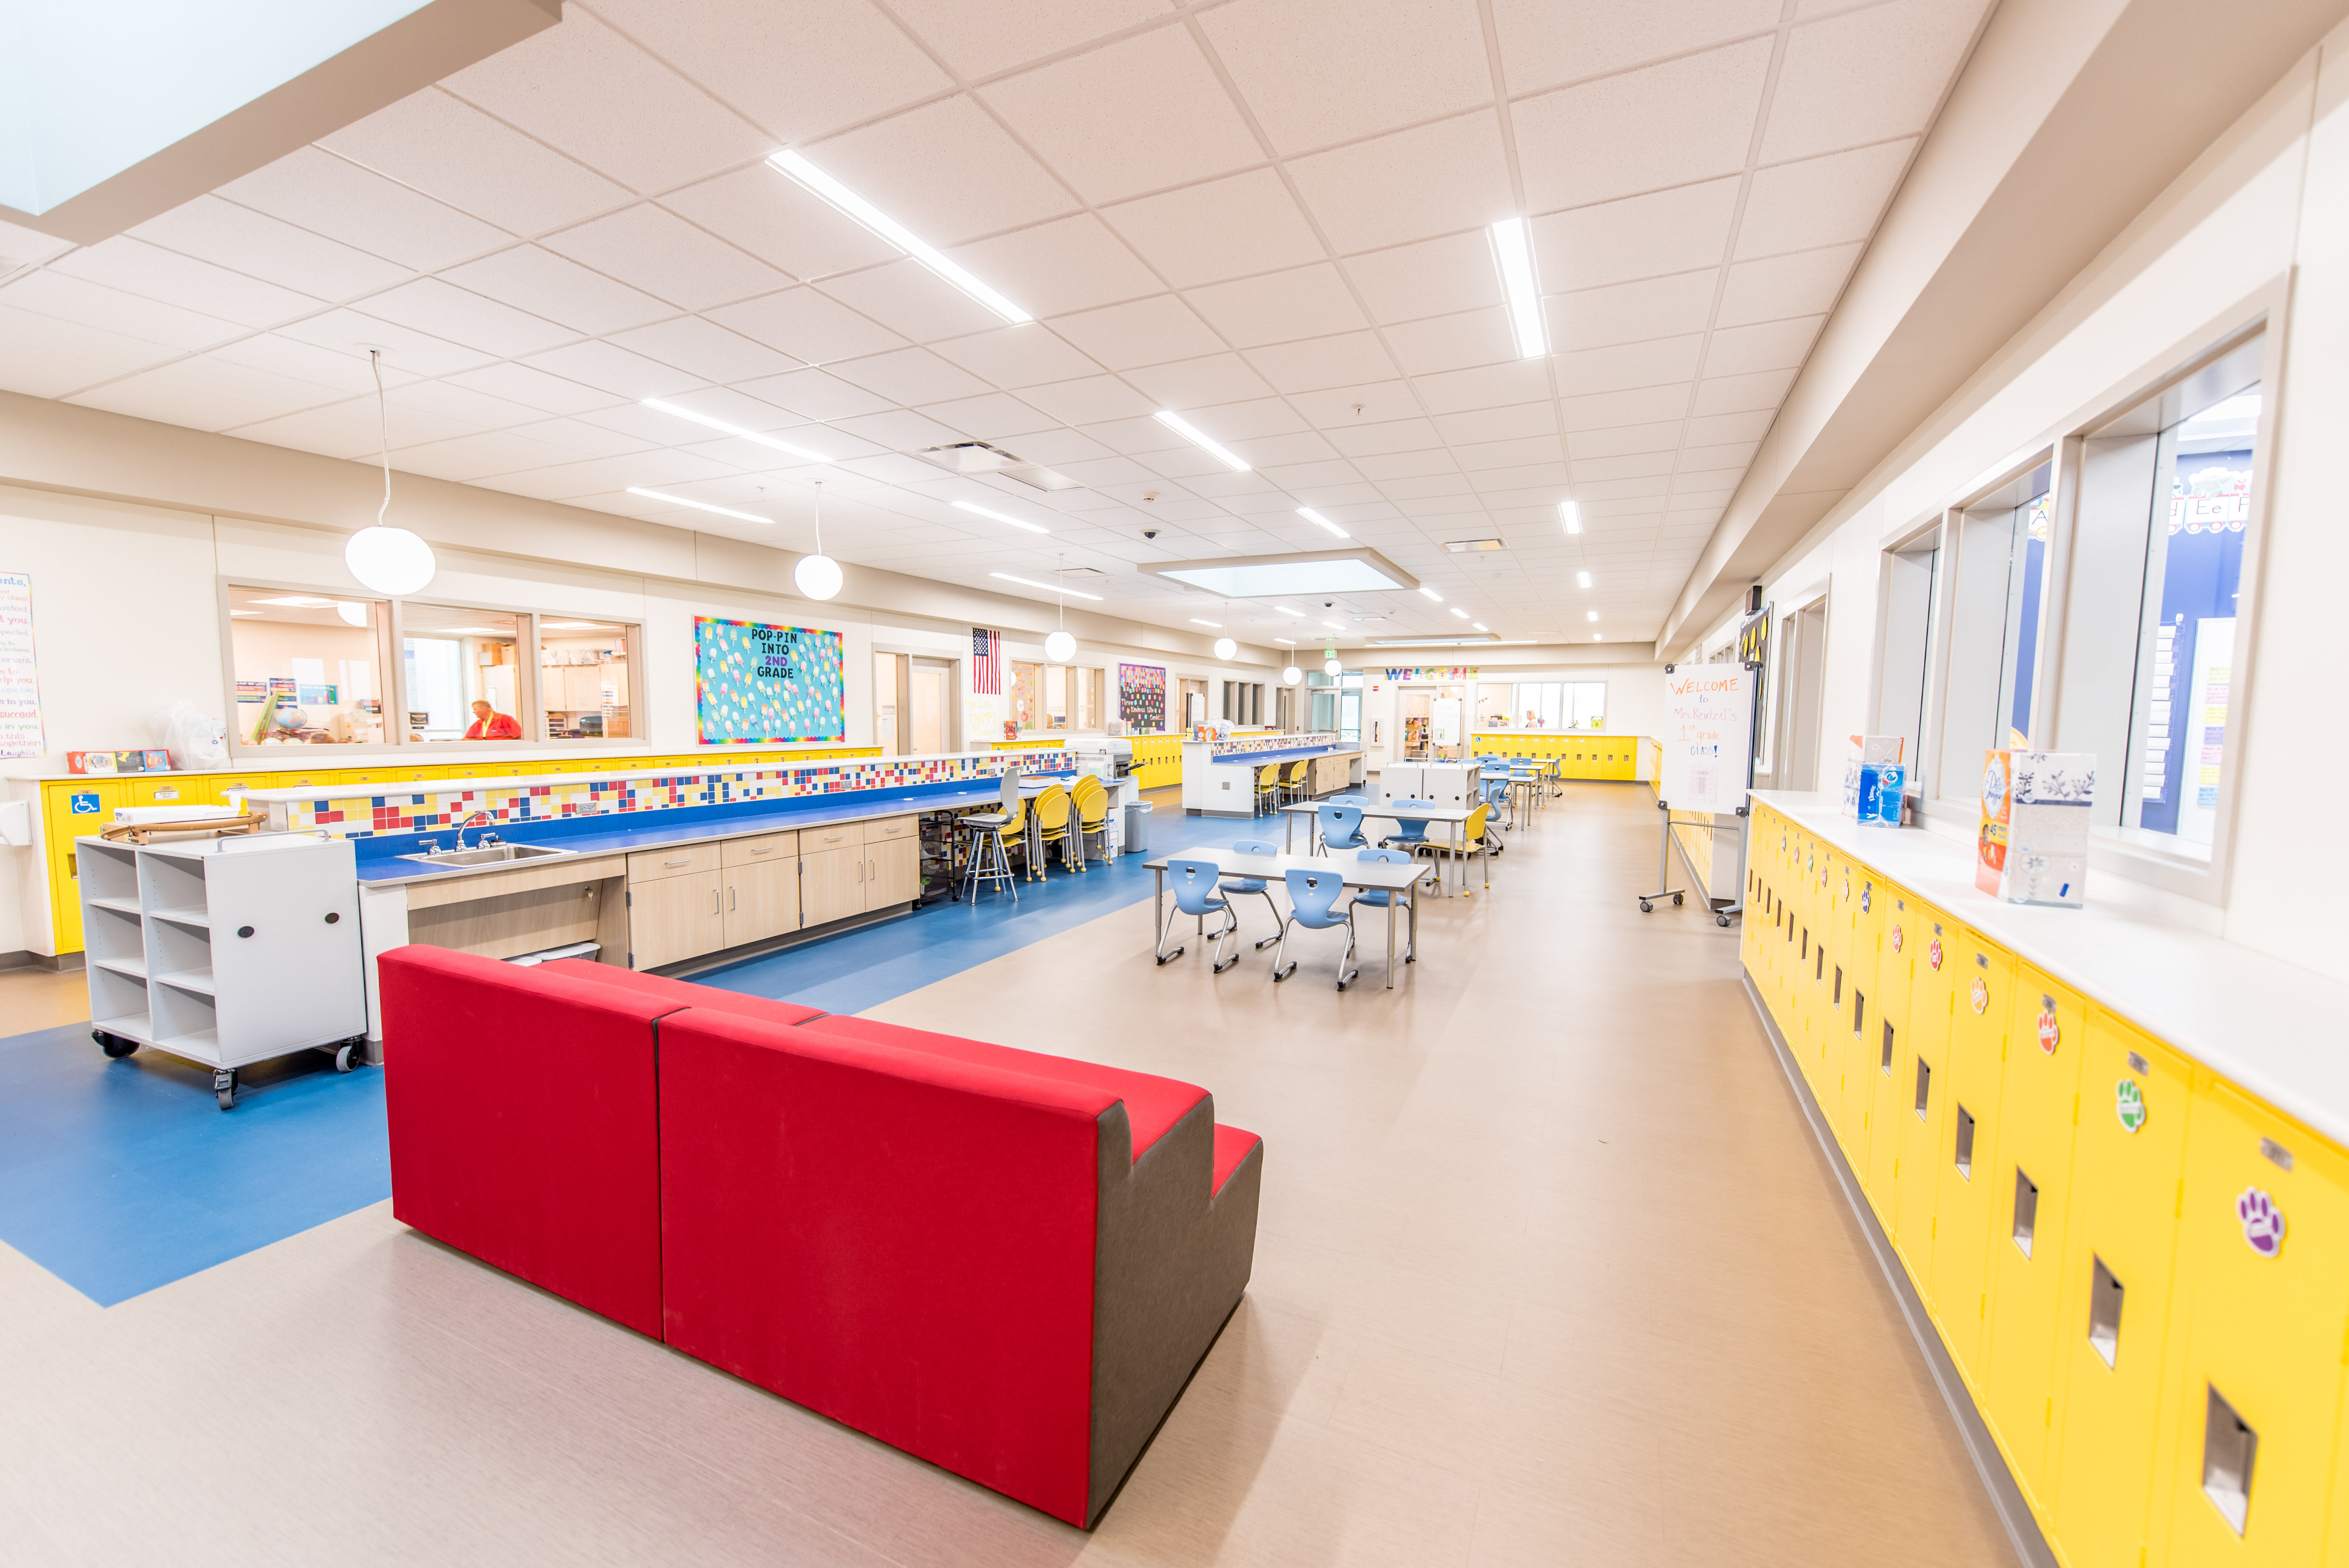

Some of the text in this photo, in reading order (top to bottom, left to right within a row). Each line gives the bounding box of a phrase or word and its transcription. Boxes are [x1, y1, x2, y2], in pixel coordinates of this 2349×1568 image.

[2196, 499, 2222, 514] Ee
[752, 629, 797, 644] POP-PIN
[761, 643, 789, 655] INTO
[765, 655, 788, 667] 2ND
[757, 666, 794, 679] GRADE
[1385, 665, 1479, 681] WELCOME
[1670, 678, 1739, 695] WELCOME
[1699, 694, 1708, 703] to
[969, 712, 997, 726] CHAMPS
[1672, 707, 1737, 722] Mrs. Reutzel's
[1677, 724, 1721, 747] 1st grade
[1690, 745, 1718, 758] CLASS!
[1868, 785, 1876, 802] Kleenex
